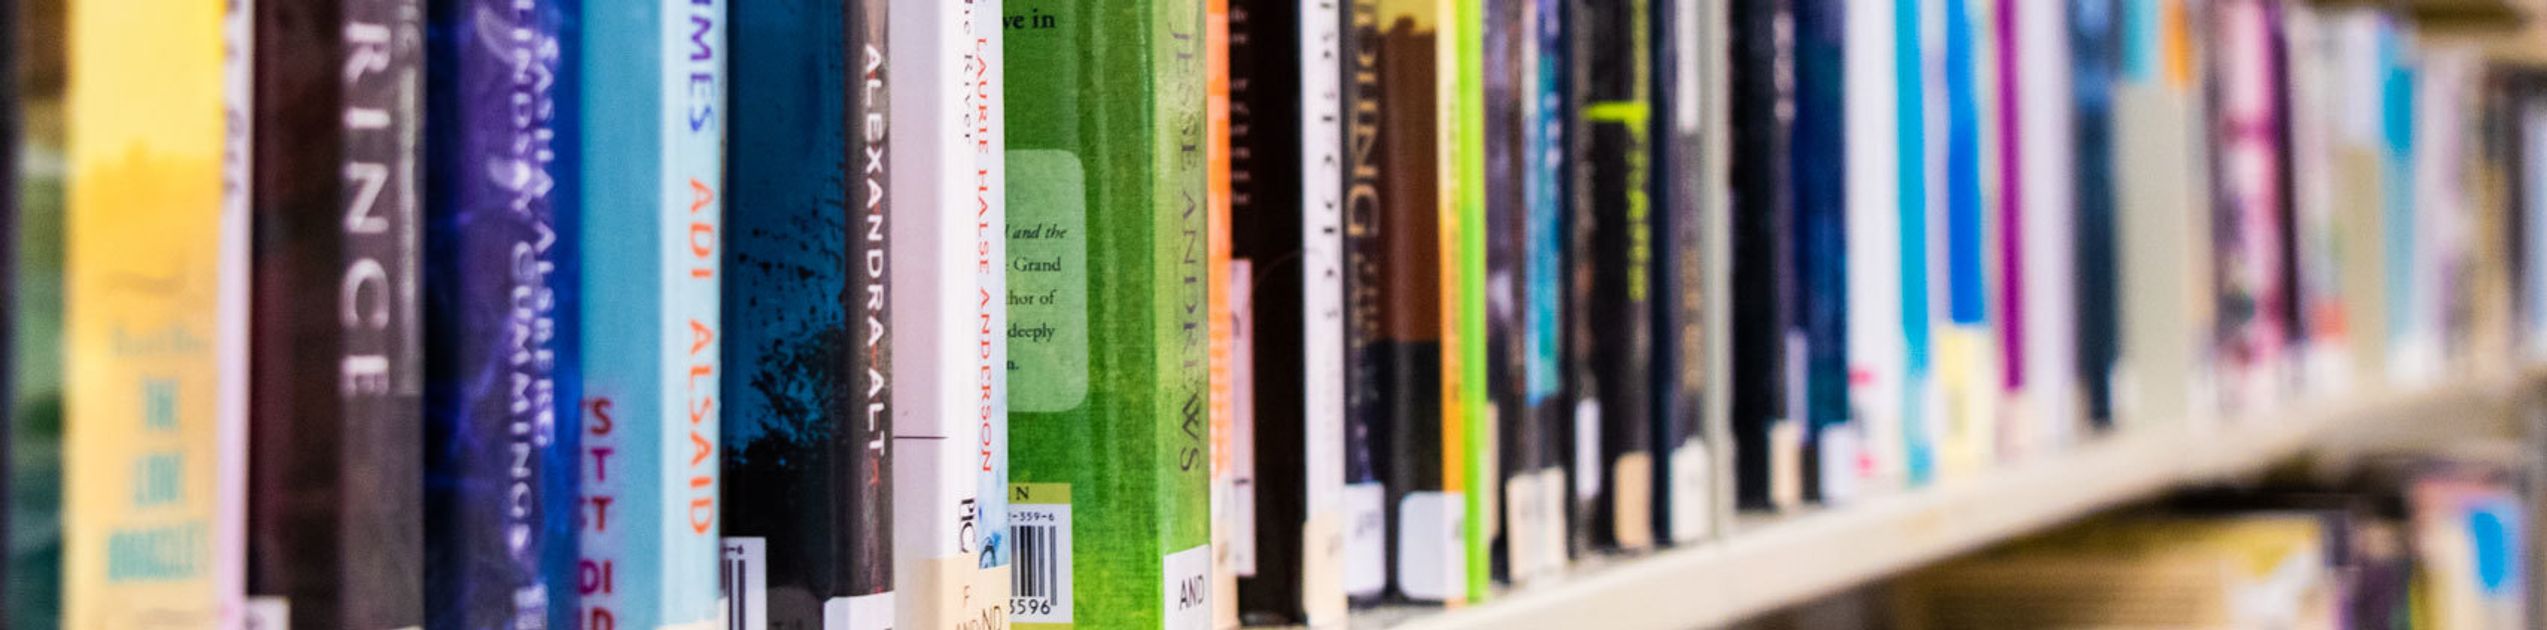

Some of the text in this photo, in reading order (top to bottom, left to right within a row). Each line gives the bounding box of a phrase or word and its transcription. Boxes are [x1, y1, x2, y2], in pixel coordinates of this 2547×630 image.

[1033, 8, 1056, 29] in
[343, 23, 391, 396] RINCE
[689, 177, 714, 278] ADI
[1013, 223, 1042, 240] and
[1045, 223, 1067, 240] the
[865, 43, 887, 458] ALEXANDRA ALT
[976, 38, 991, 472] LAURIE HALSE ANDERSON
[1014, 256, 1061, 272] Grand
[1167, 20, 1199, 472] JESSE ANDREWS
[1039, 289, 1057, 305] of
[1007, 322, 1055, 342] deeply
[689, 318, 714, 535] ALSAID
[1008, 511, 1055, 521] -359-6
